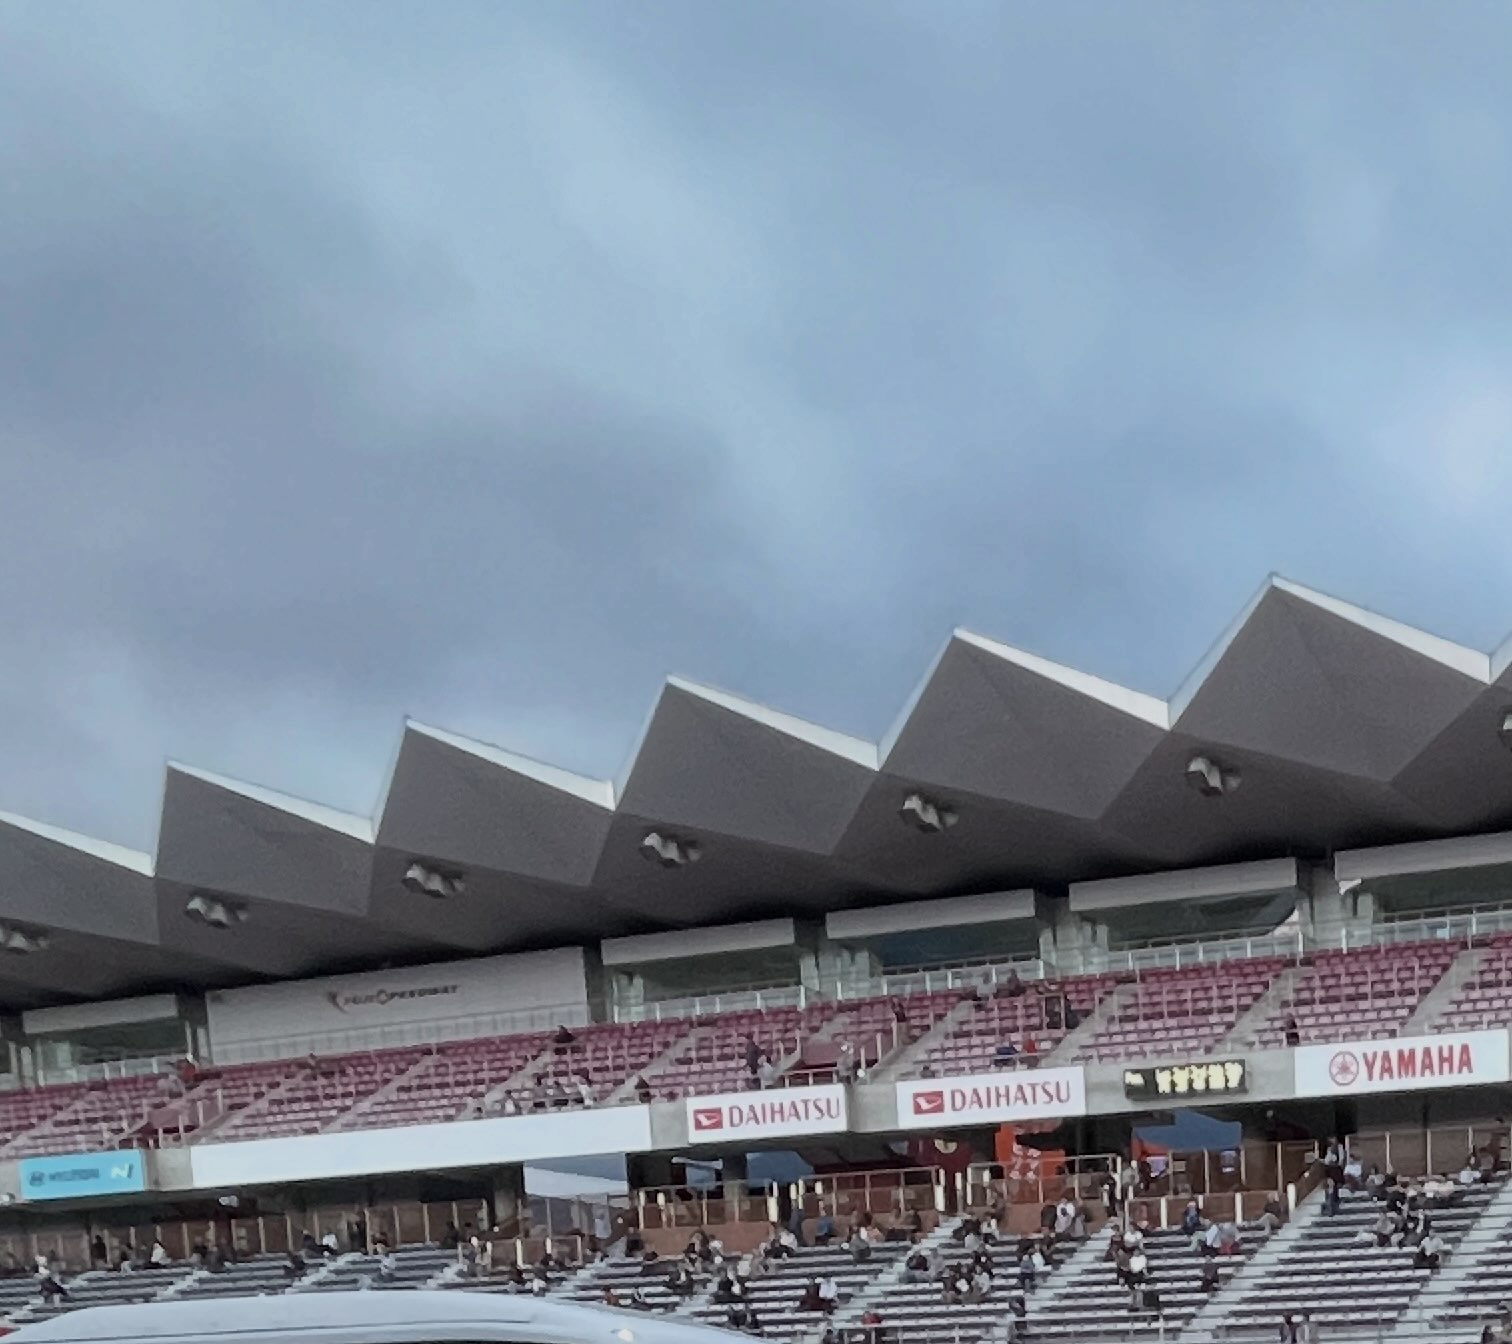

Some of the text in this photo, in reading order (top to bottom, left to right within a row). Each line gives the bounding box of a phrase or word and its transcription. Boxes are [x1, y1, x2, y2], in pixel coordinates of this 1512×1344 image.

[1362, 1043, 1473, 1082] YAMAHA
[951, 1080, 1072, 1112] DAIHATSU
[728, 1097, 841, 1128] DAIHATSU
